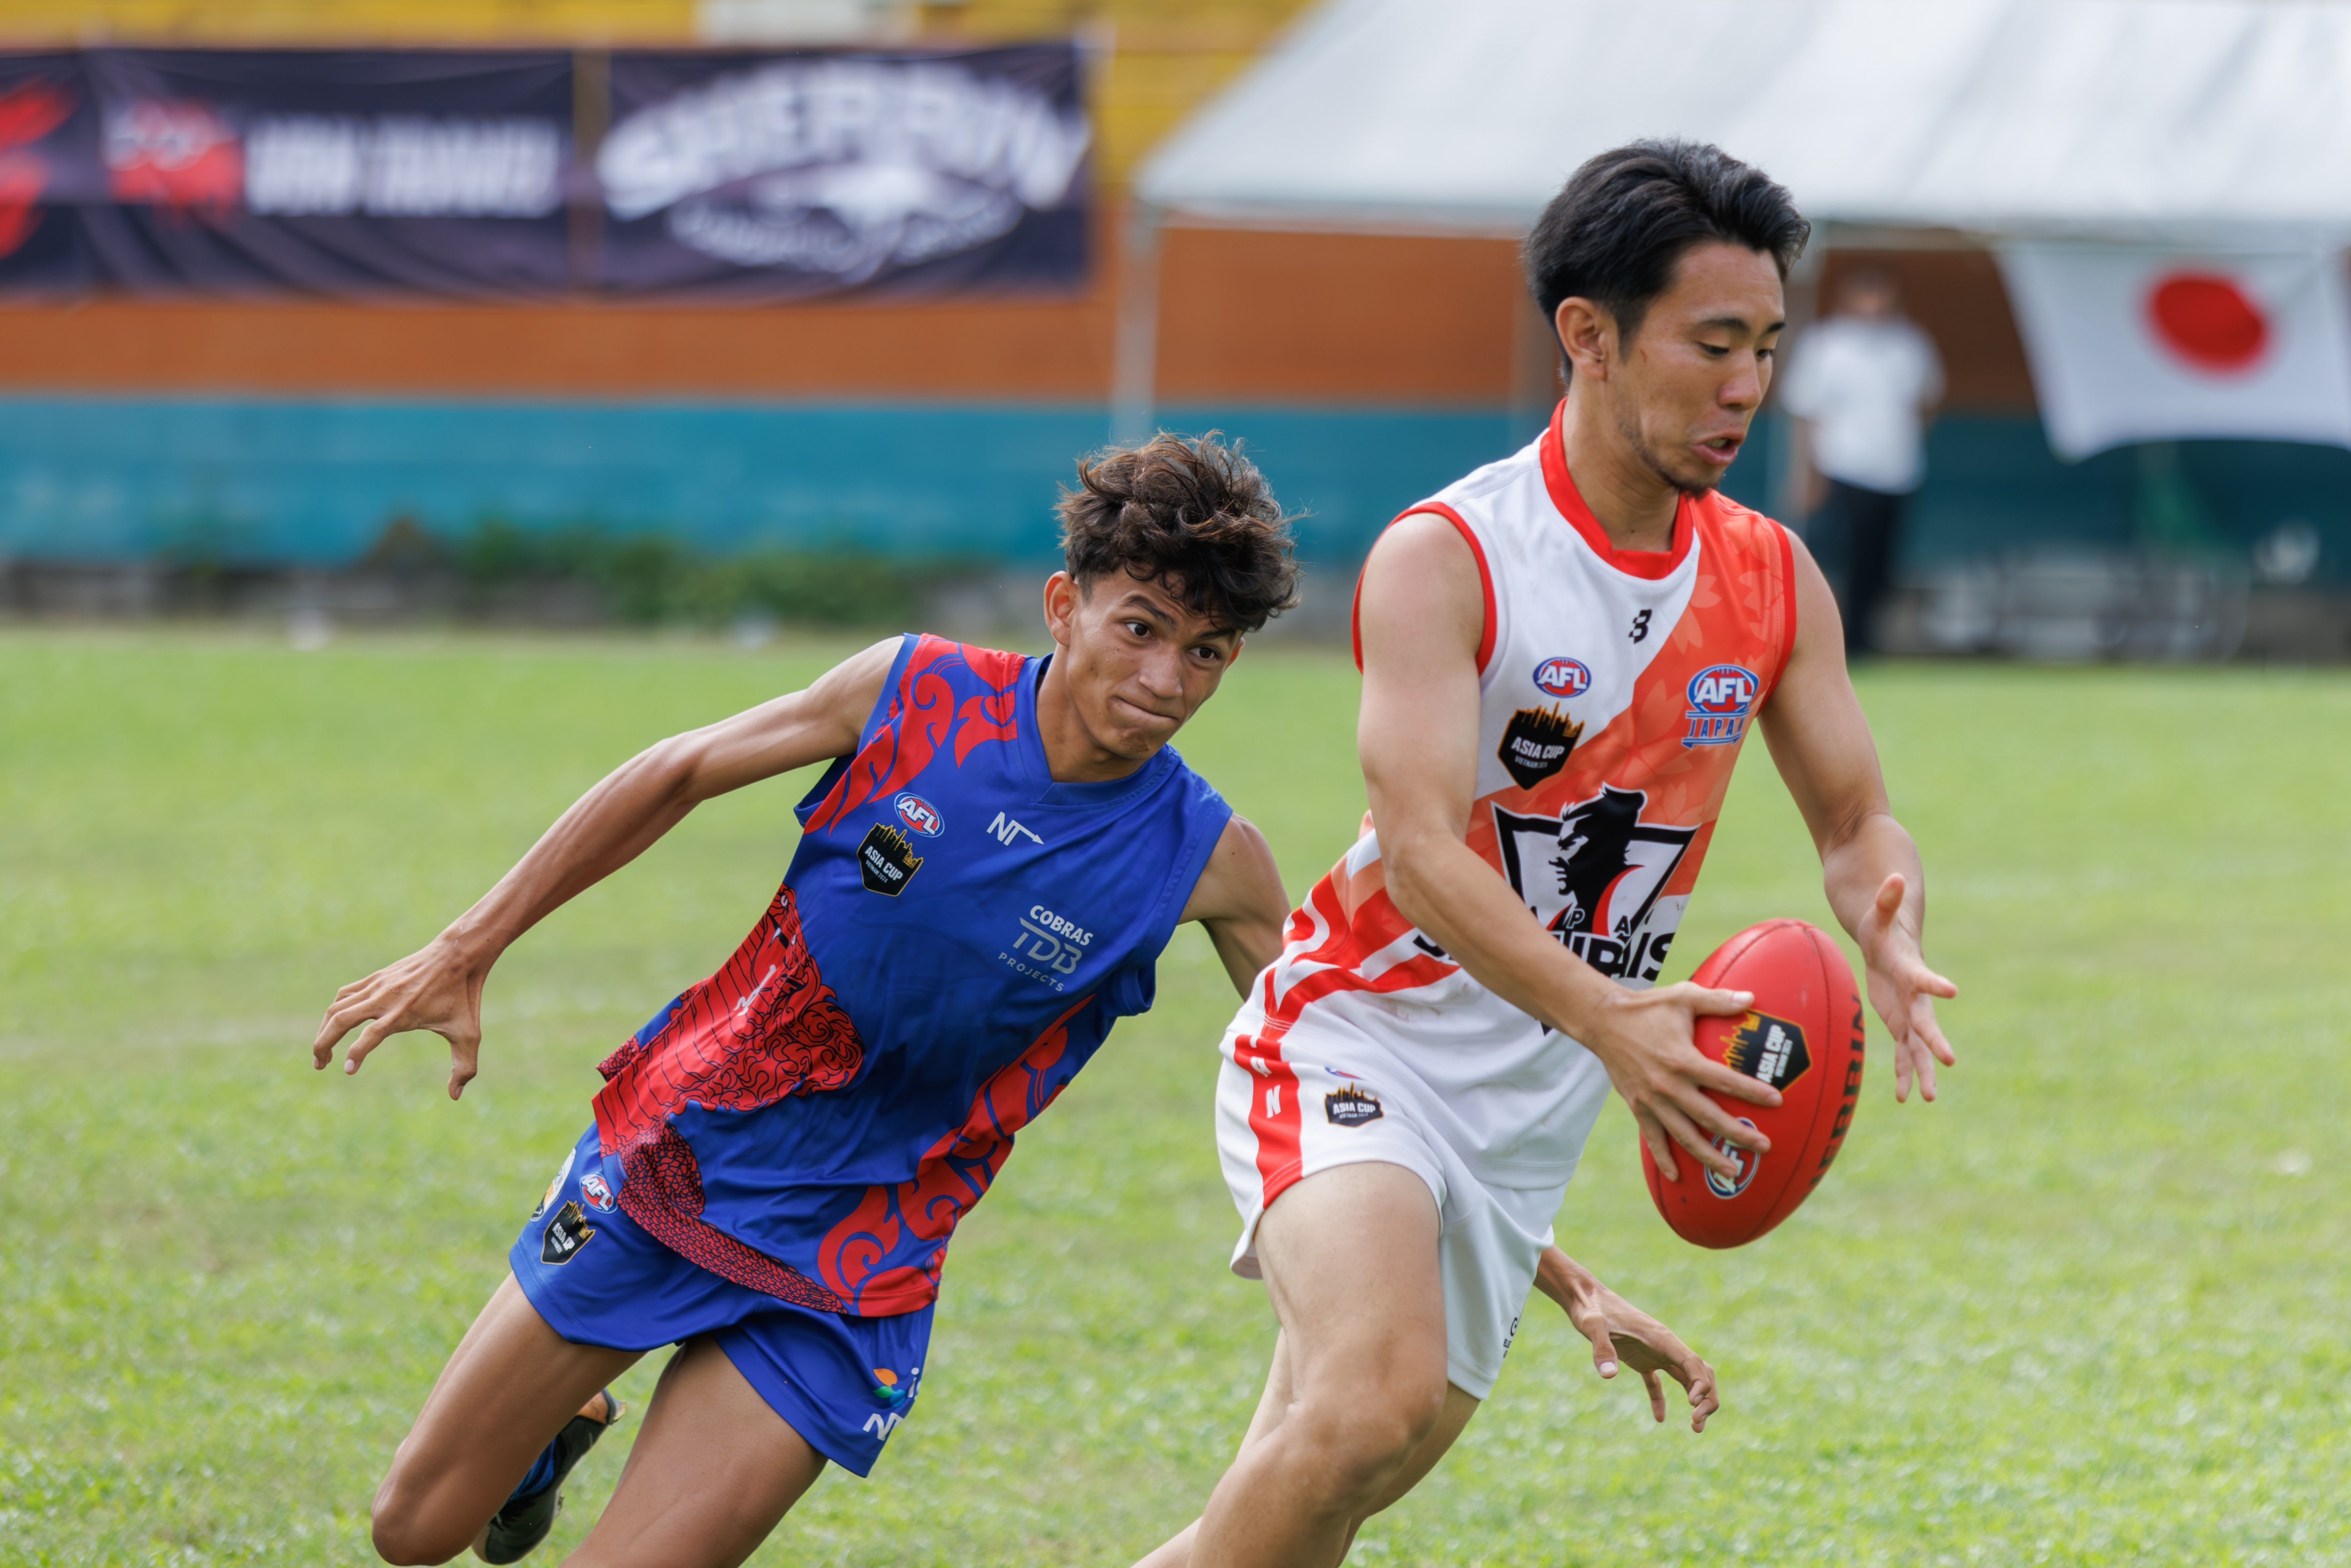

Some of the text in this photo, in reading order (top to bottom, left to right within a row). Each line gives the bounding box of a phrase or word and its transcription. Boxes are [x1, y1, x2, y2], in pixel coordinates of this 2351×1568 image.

[1537, 664, 1587, 689] AFL
[1694, 678, 1752, 703] AFL
[1511, 736, 1565, 759] ASIA CUP
[1514, 756, 1538, 769] VIETNAM
[897, 798, 936, 835] AFL
[865, 845, 903, 881] ASIA CUP
[865, 859, 879, 876] VIETNAM
[1030, 905, 1094, 946] COBRAS
[1012, 917, 1082, 974] TDB
[998, 952, 1064, 992] PROJECTS
[1333, 1102, 1376, 1115] ASIA CUP
[582, 1177, 610, 1212] AFL
[552, 1222, 567, 1243] ASIA
